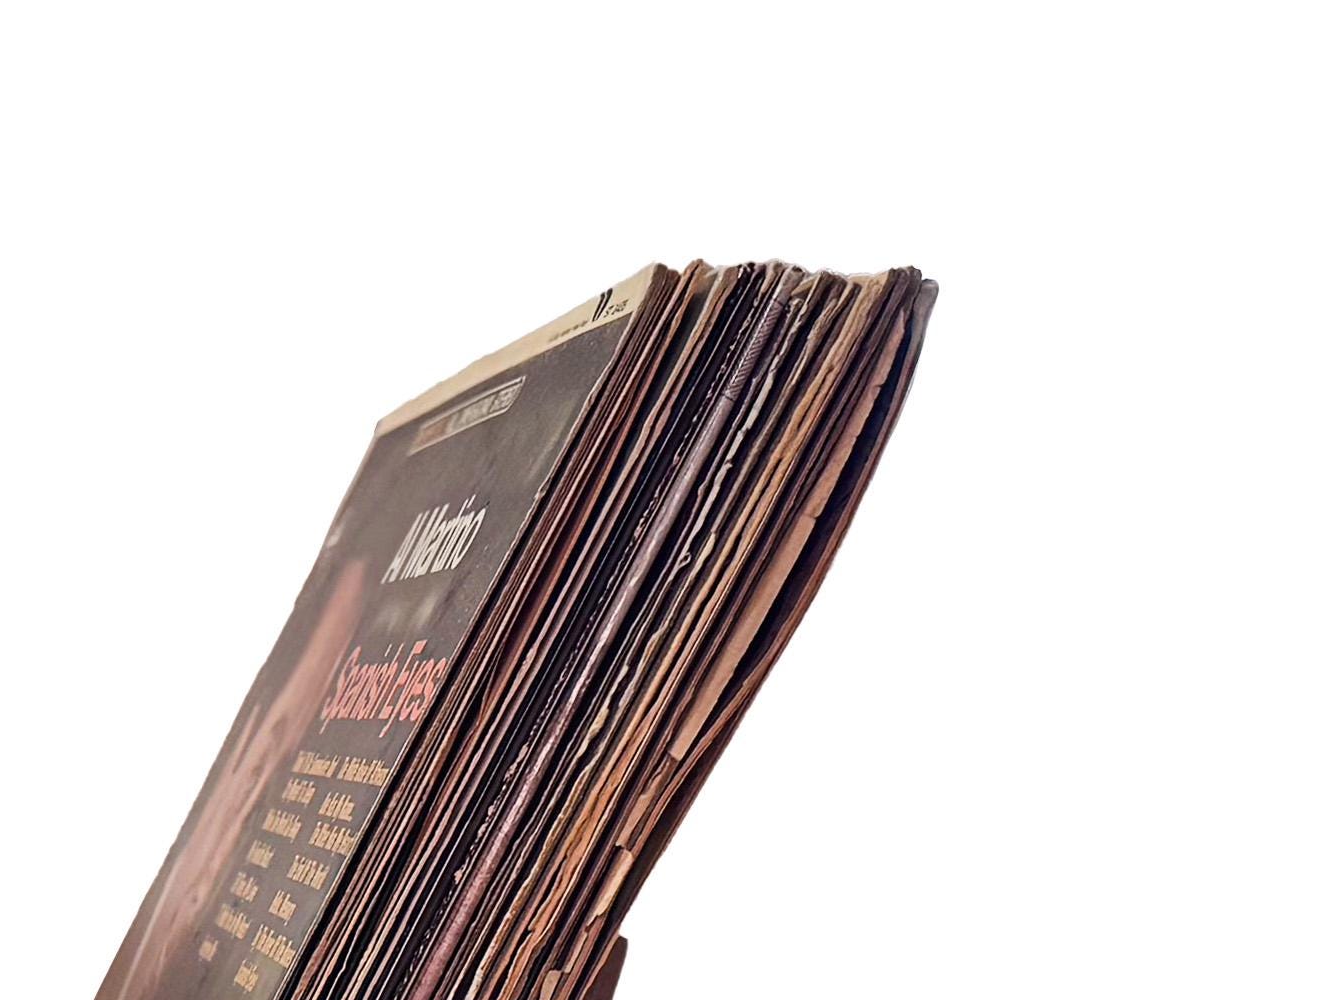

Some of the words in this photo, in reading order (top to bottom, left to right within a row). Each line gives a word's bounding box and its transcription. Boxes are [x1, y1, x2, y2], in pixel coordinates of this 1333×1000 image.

[381, 510, 430, 584] Al
[399, 494, 487, 580] Martino
[319, 642, 405, 735] Spanish
[378, 639, 450, 738] Eyes
